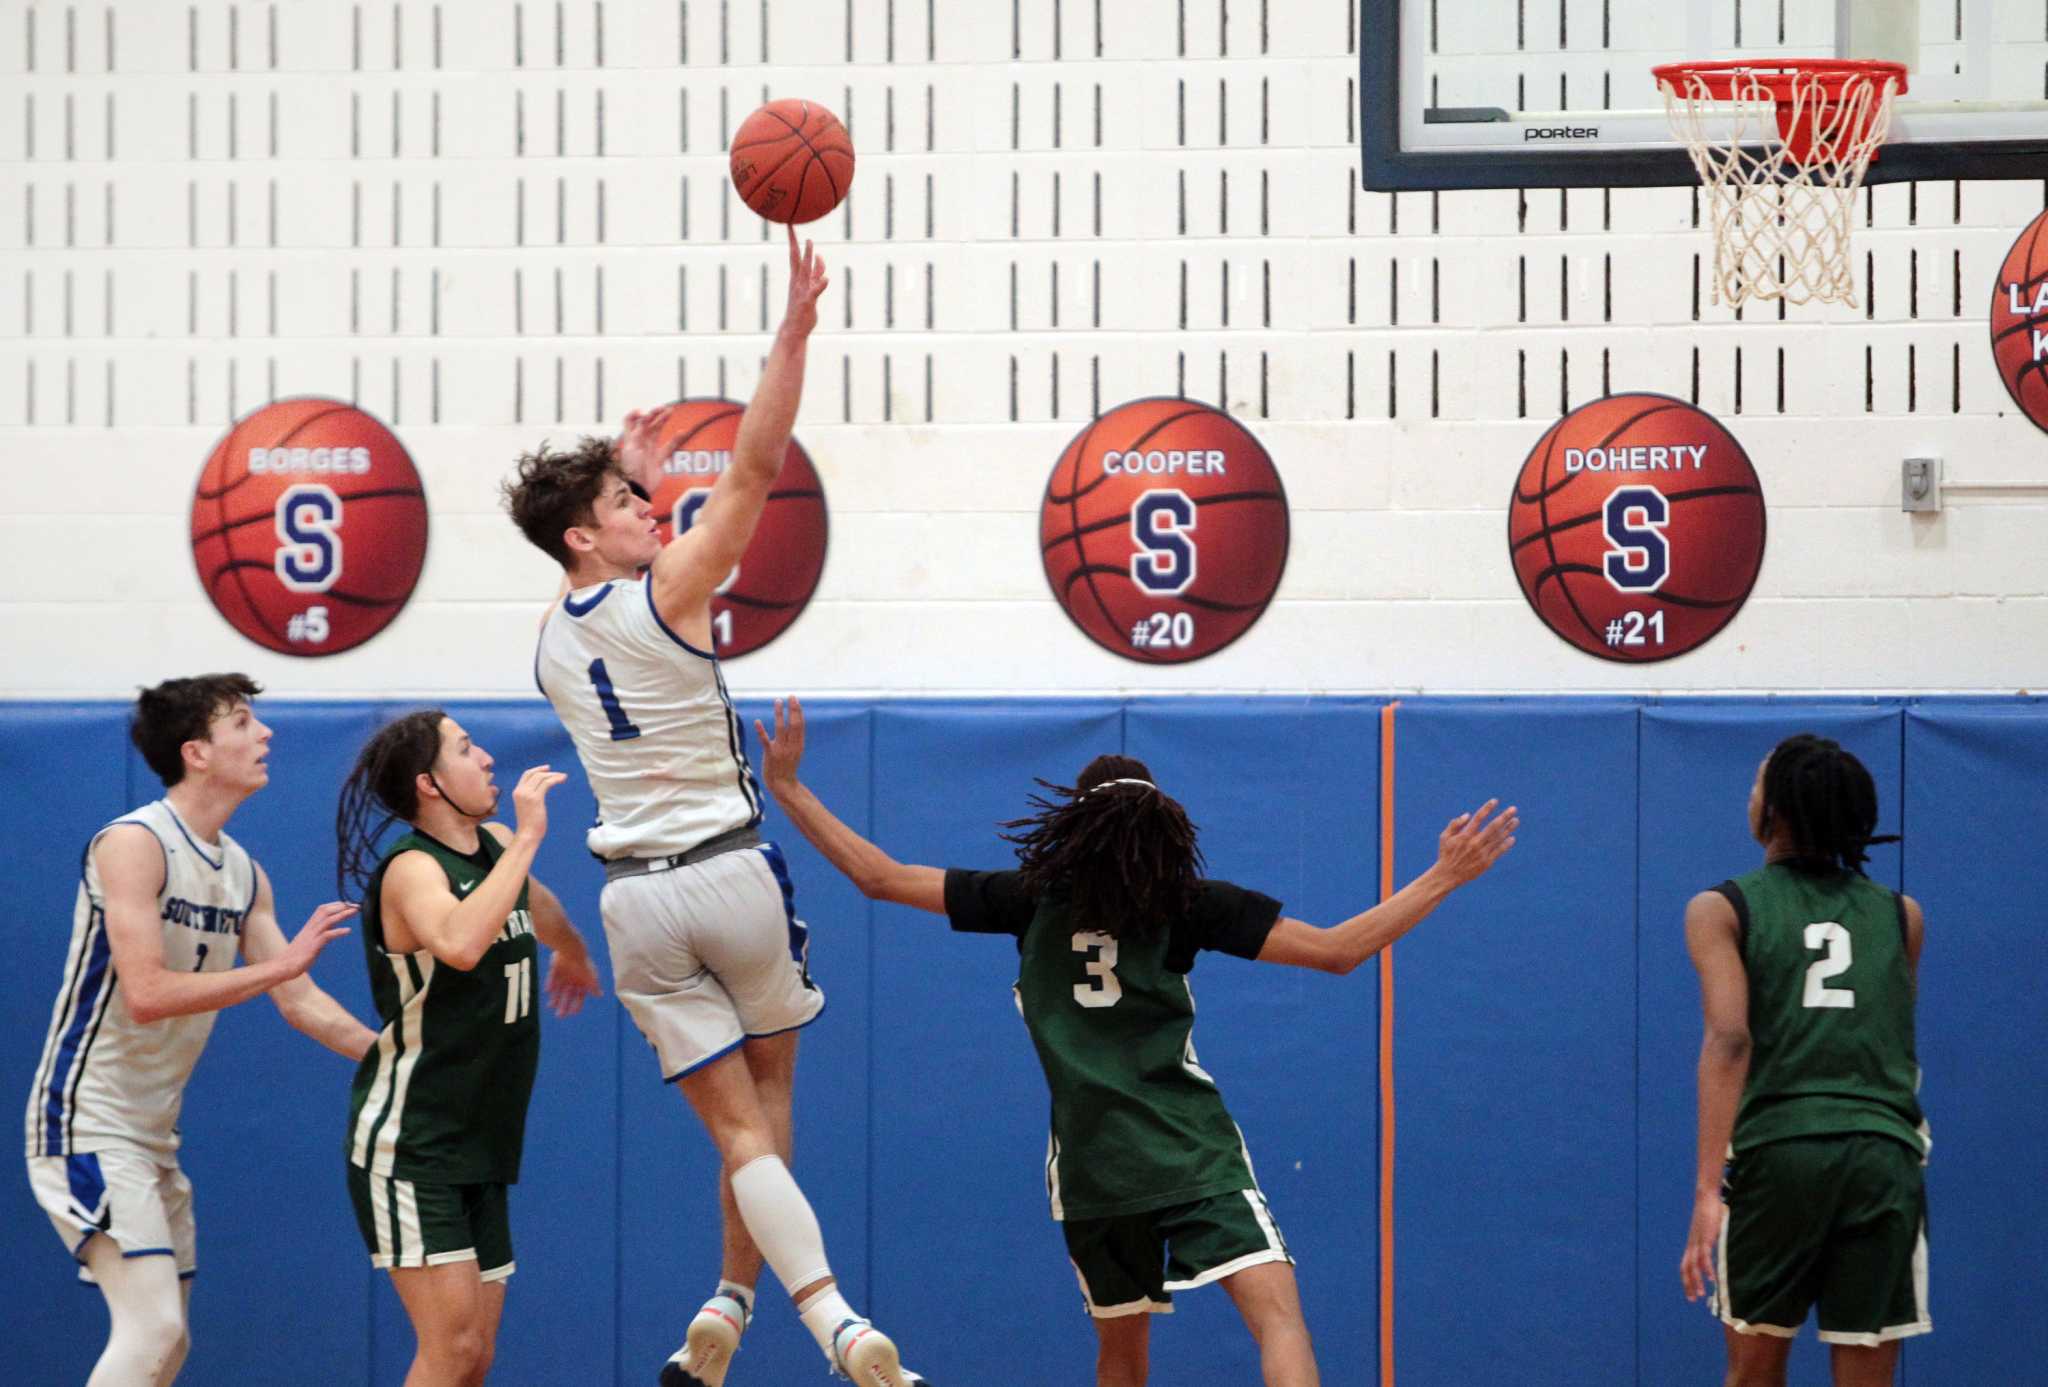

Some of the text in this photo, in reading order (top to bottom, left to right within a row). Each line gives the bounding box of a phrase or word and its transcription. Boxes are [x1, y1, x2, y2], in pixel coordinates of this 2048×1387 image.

[248, 447, 371, 474] BORGES
[1102, 450, 1226, 475] COOPER
[1564, 445, 1707, 472] DOHERTY
[274, 483, 343, 593] S
[1131, 488, 1196, 595] S
[1602, 484, 1670, 594] S
[287, 606, 330, 643] #5
[1132, 612, 1194, 647] #20
[1605, 610, 1666, 645] #21
[588, 658, 641, 741] 1
[504, 956, 531, 1024] 11
[1071, 930, 1123, 1008] 3
[1802, 921, 1855, 1009] 2
